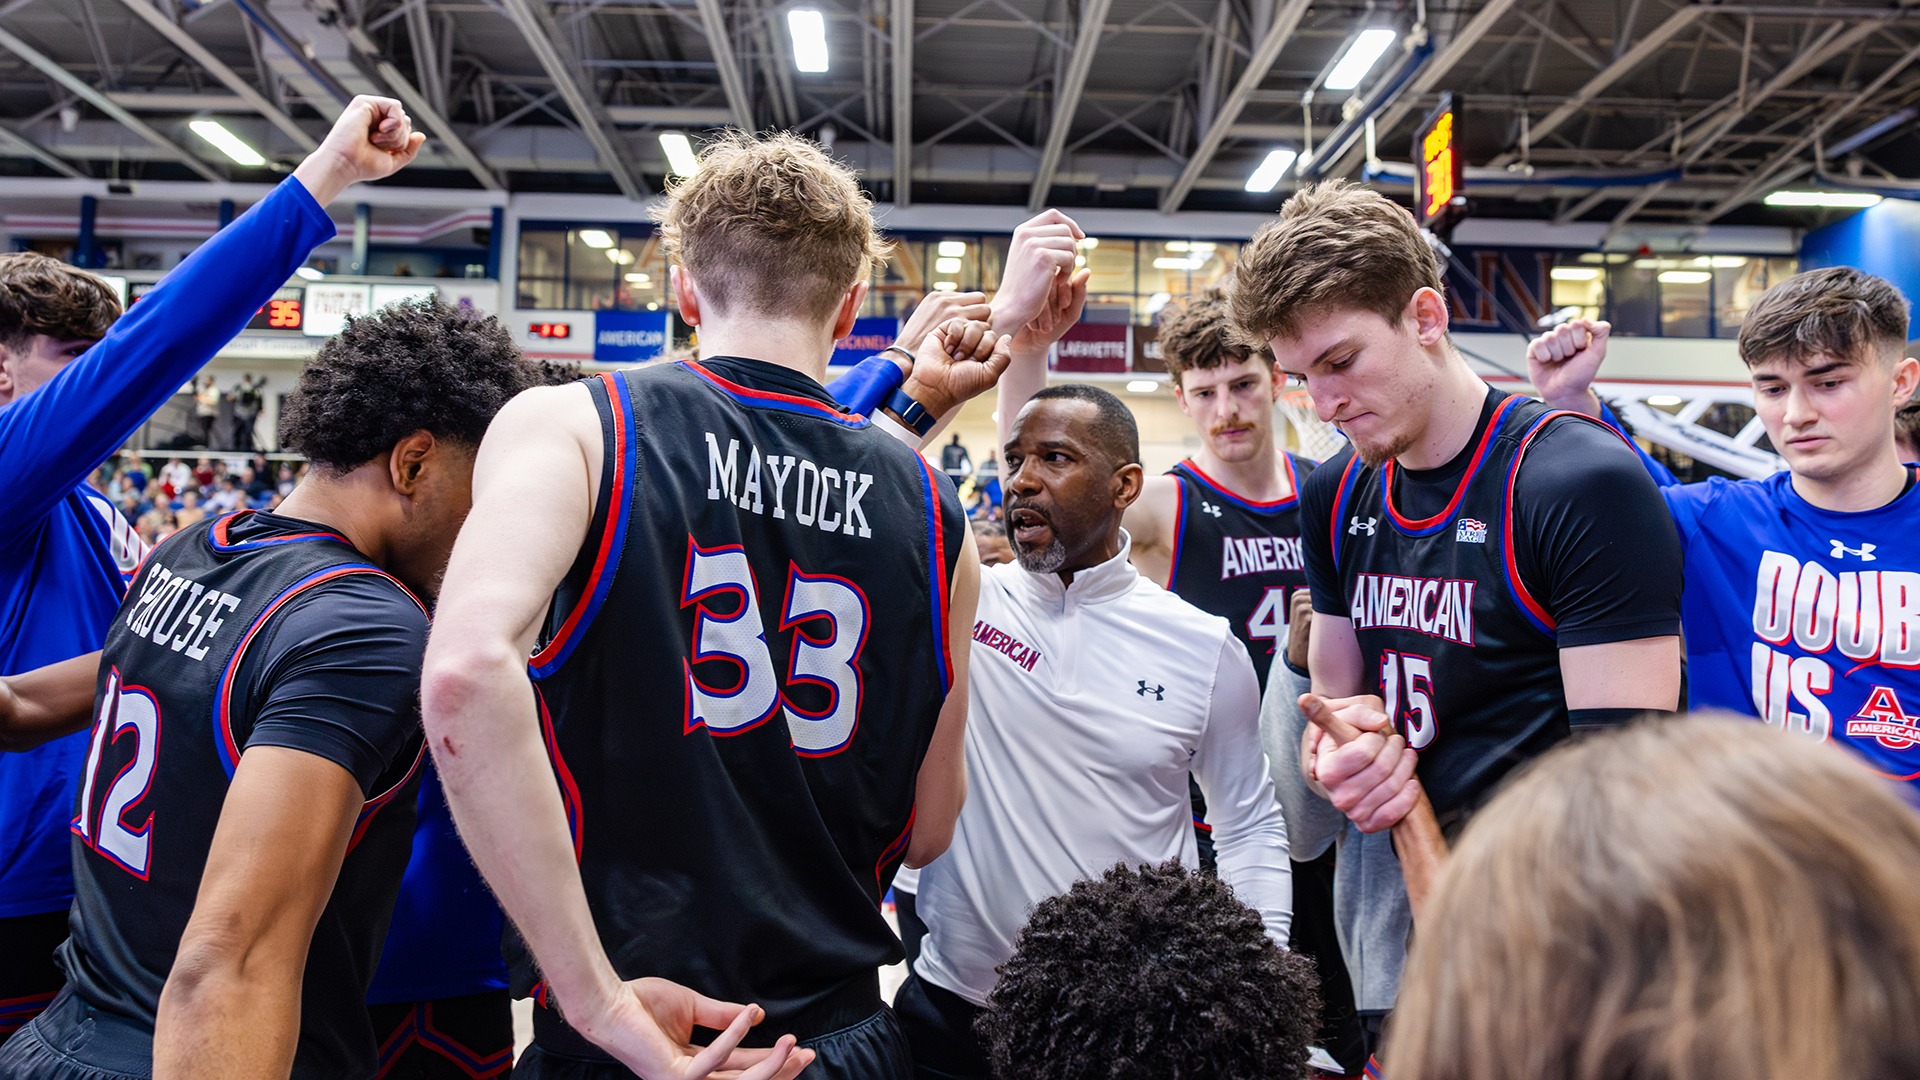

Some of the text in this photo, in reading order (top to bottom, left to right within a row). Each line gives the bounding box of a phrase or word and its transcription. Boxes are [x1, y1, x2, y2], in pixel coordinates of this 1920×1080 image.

[269, 300, 301, 328] 35
[598, 330, 663, 347] AMERICAN
[1058, 341, 1126, 358] LAFAYETTE
[705, 432, 873, 539] MAYOCK
[126, 562, 242, 662] SPROUSE
[680, 532, 872, 759] 33
[972, 620, 1042, 673] AMERICAN
[1246, 586, 1311, 655] 4
[1353, 573, 1477, 647] AMERICAN
[1752, 550, 1920, 669] DOUB
[1379, 649, 1440, 752] 15
[1751, 641, 1834, 744] US
[71, 665, 160, 881] 12
